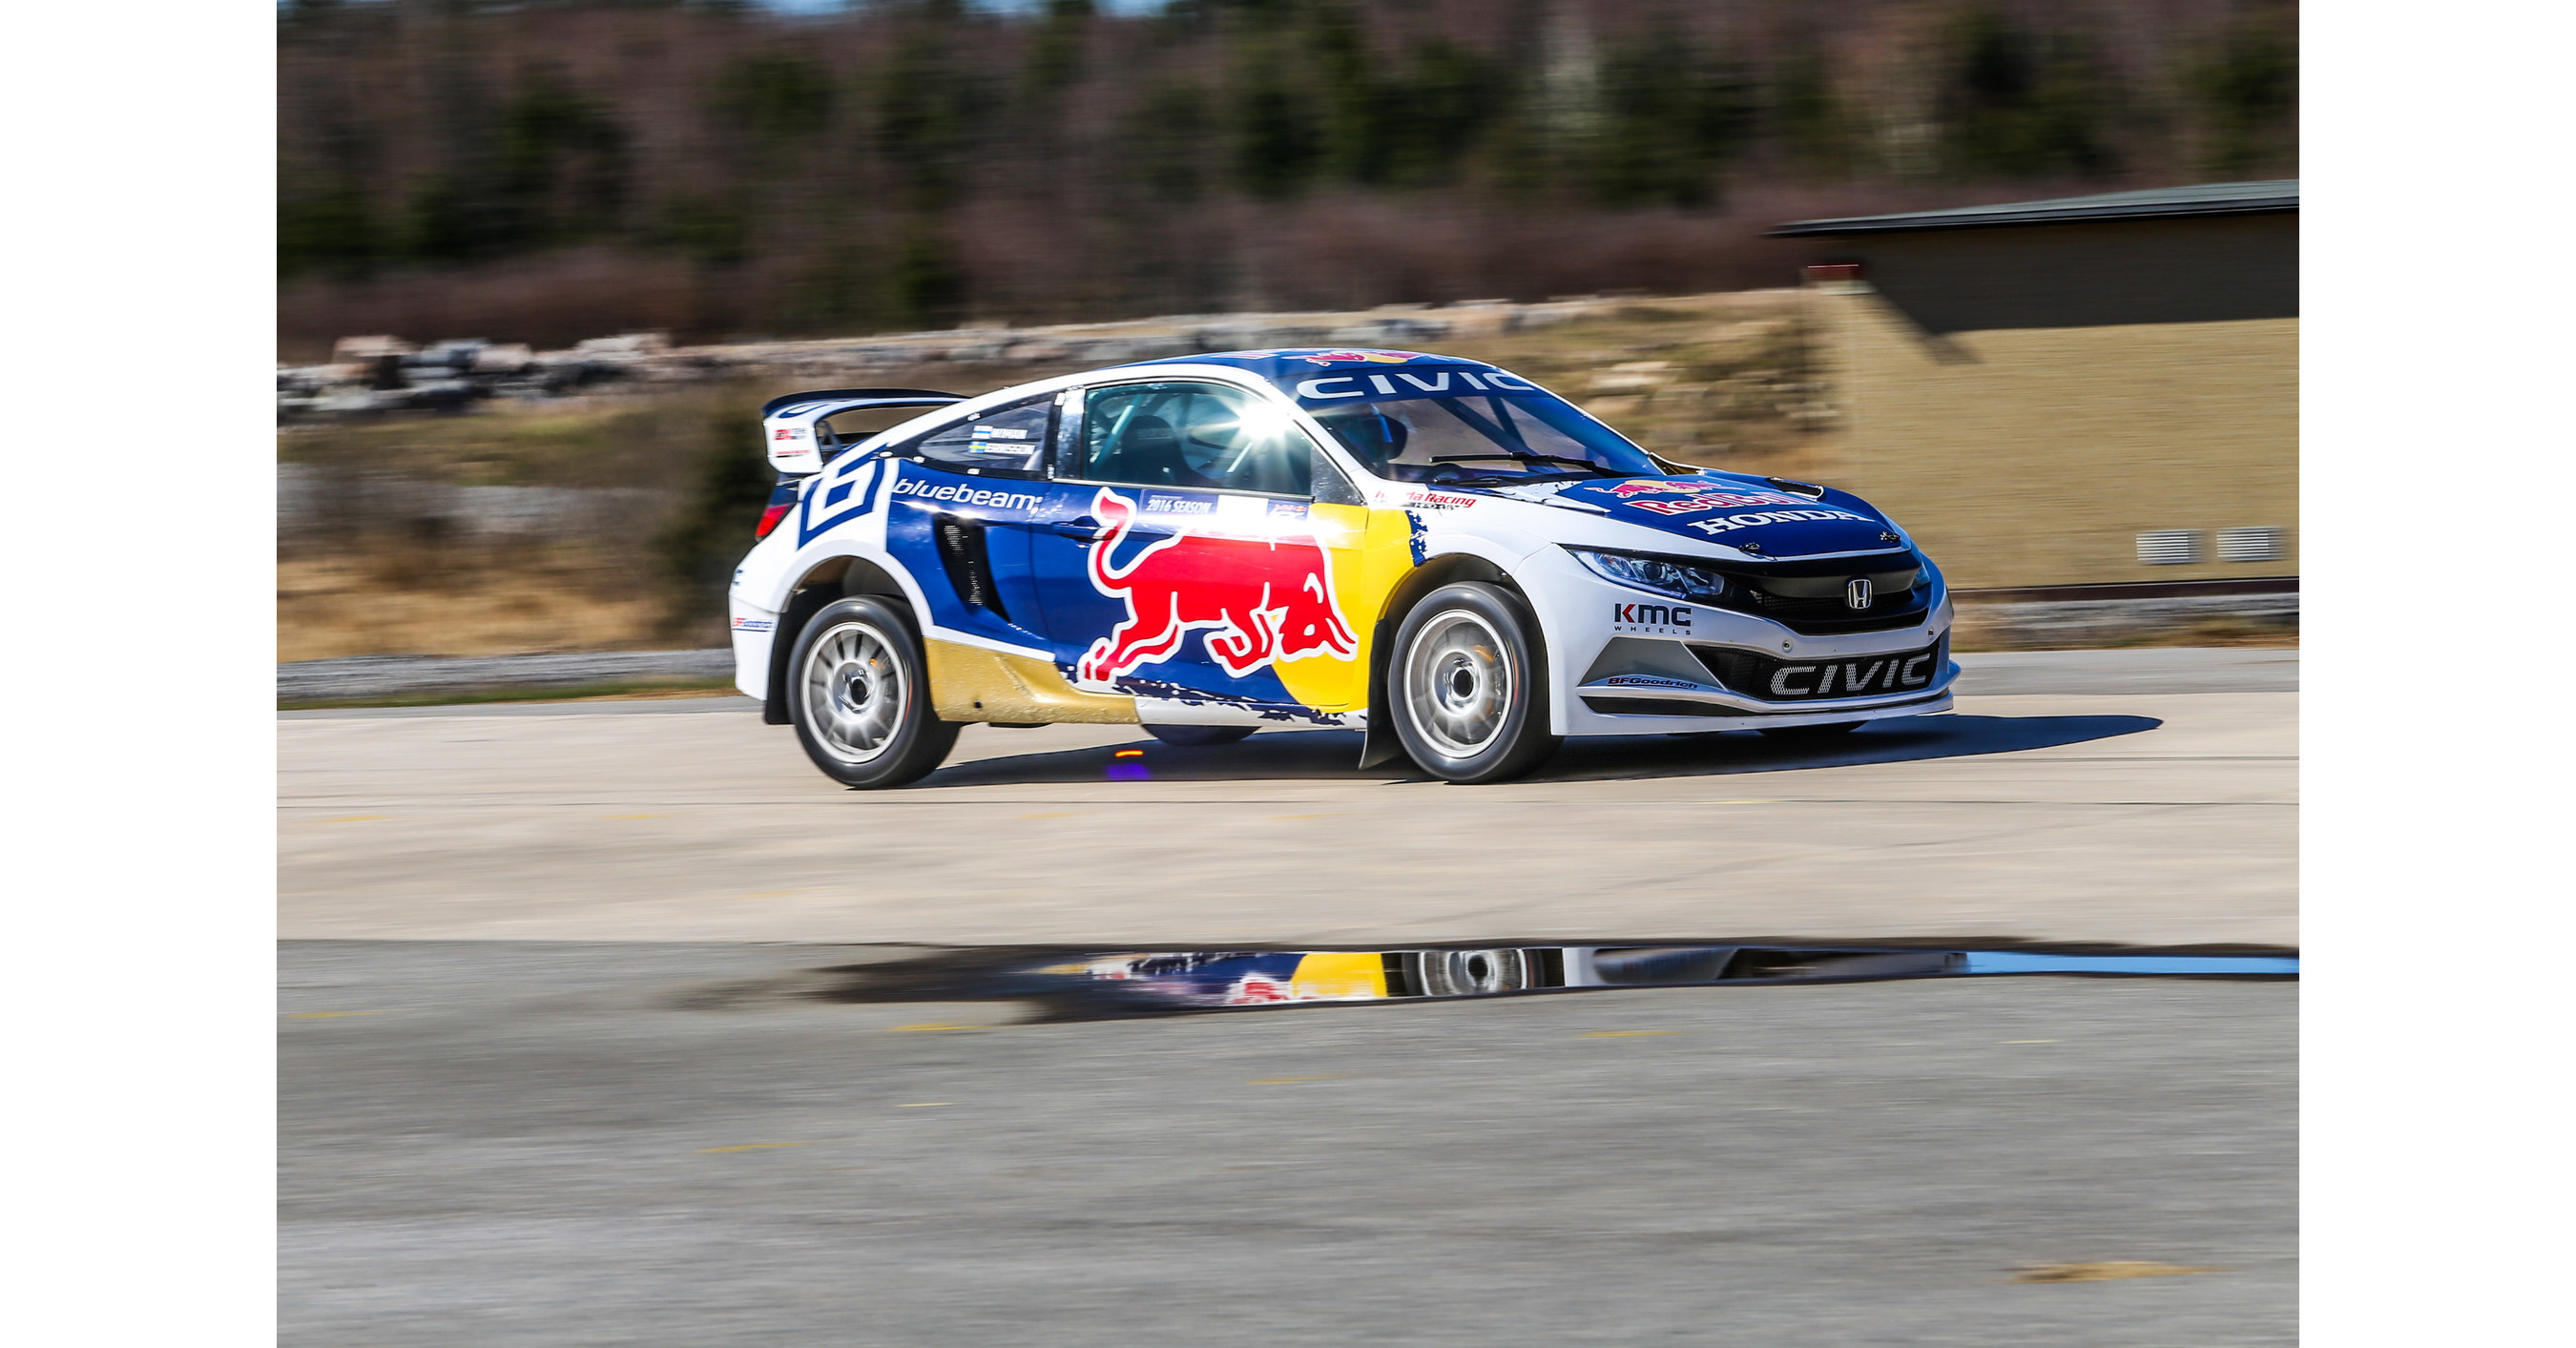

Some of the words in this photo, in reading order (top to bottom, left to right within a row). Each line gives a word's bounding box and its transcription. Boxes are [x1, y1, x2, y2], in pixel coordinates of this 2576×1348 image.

[1297, 372, 1534, 399] CIVIC
[1146, 499, 1173, 512] 2016
[1172, 501, 1213, 515] SEASON
[1423, 493, 1477, 508] Racing
[1687, 510, 1875, 535] HONDA
[1614, 603, 1692, 627] KMC
[1614, 626, 1691, 635] WHEELS
[1608, 677, 1698, 689] BFGoodrich
[1771, 653, 1930, 695] CIVIC
